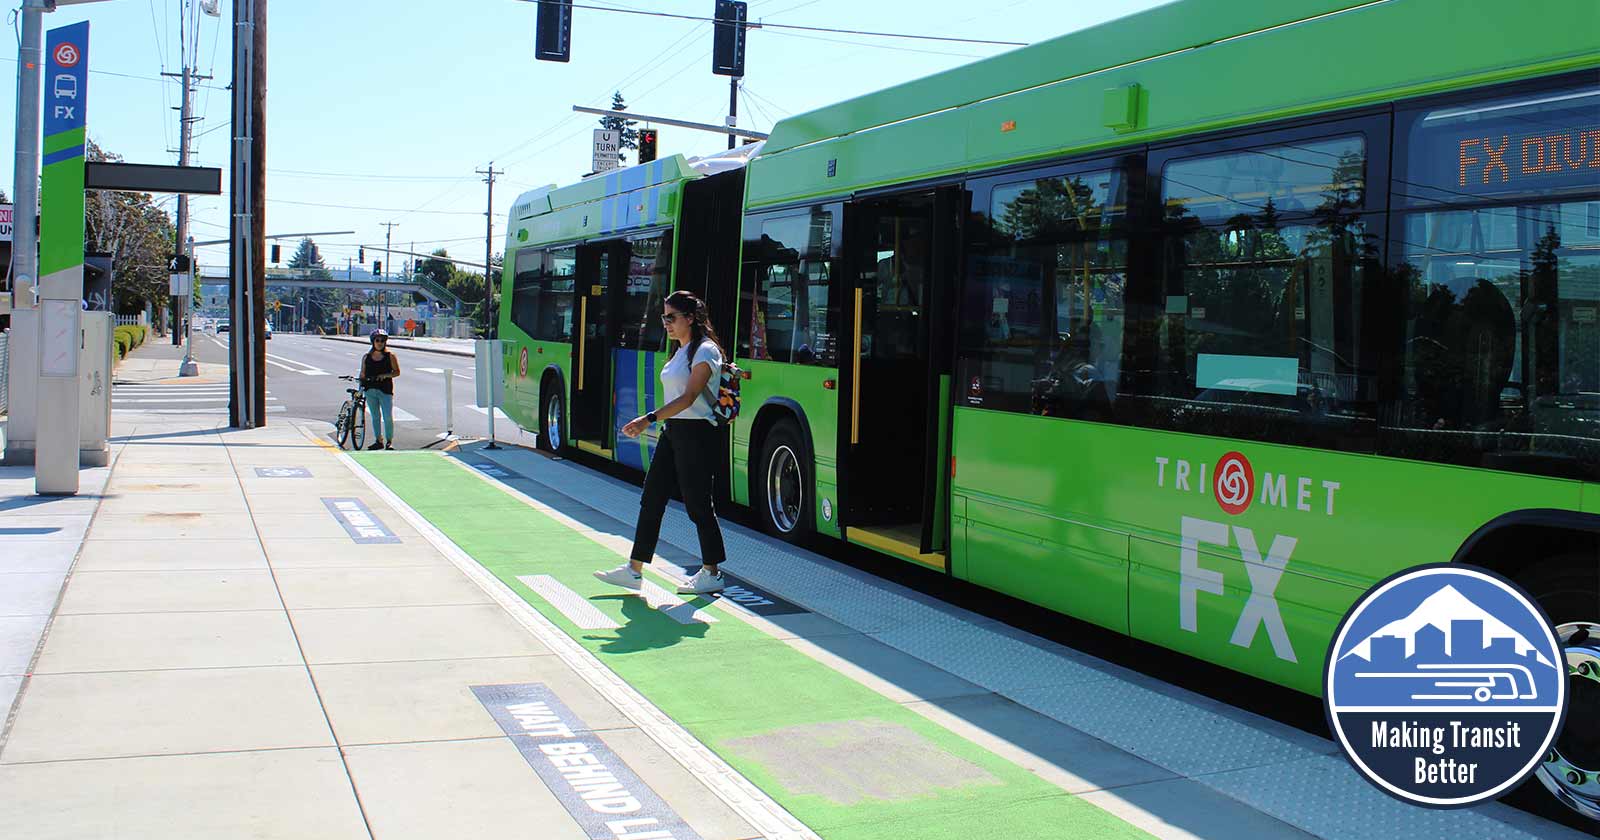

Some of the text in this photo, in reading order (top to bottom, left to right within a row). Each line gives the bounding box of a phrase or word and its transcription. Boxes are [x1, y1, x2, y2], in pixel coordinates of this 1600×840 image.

[54, 105, 75, 120] FX
[596, 143, 616, 152] TURN
[602, 132, 610, 140] U
[1458, 135, 1509, 187] FX
[1179, 515, 1299, 664] FX
[505, 701, 576, 739] WAIT
[538, 742, 643, 814] BEHIND
